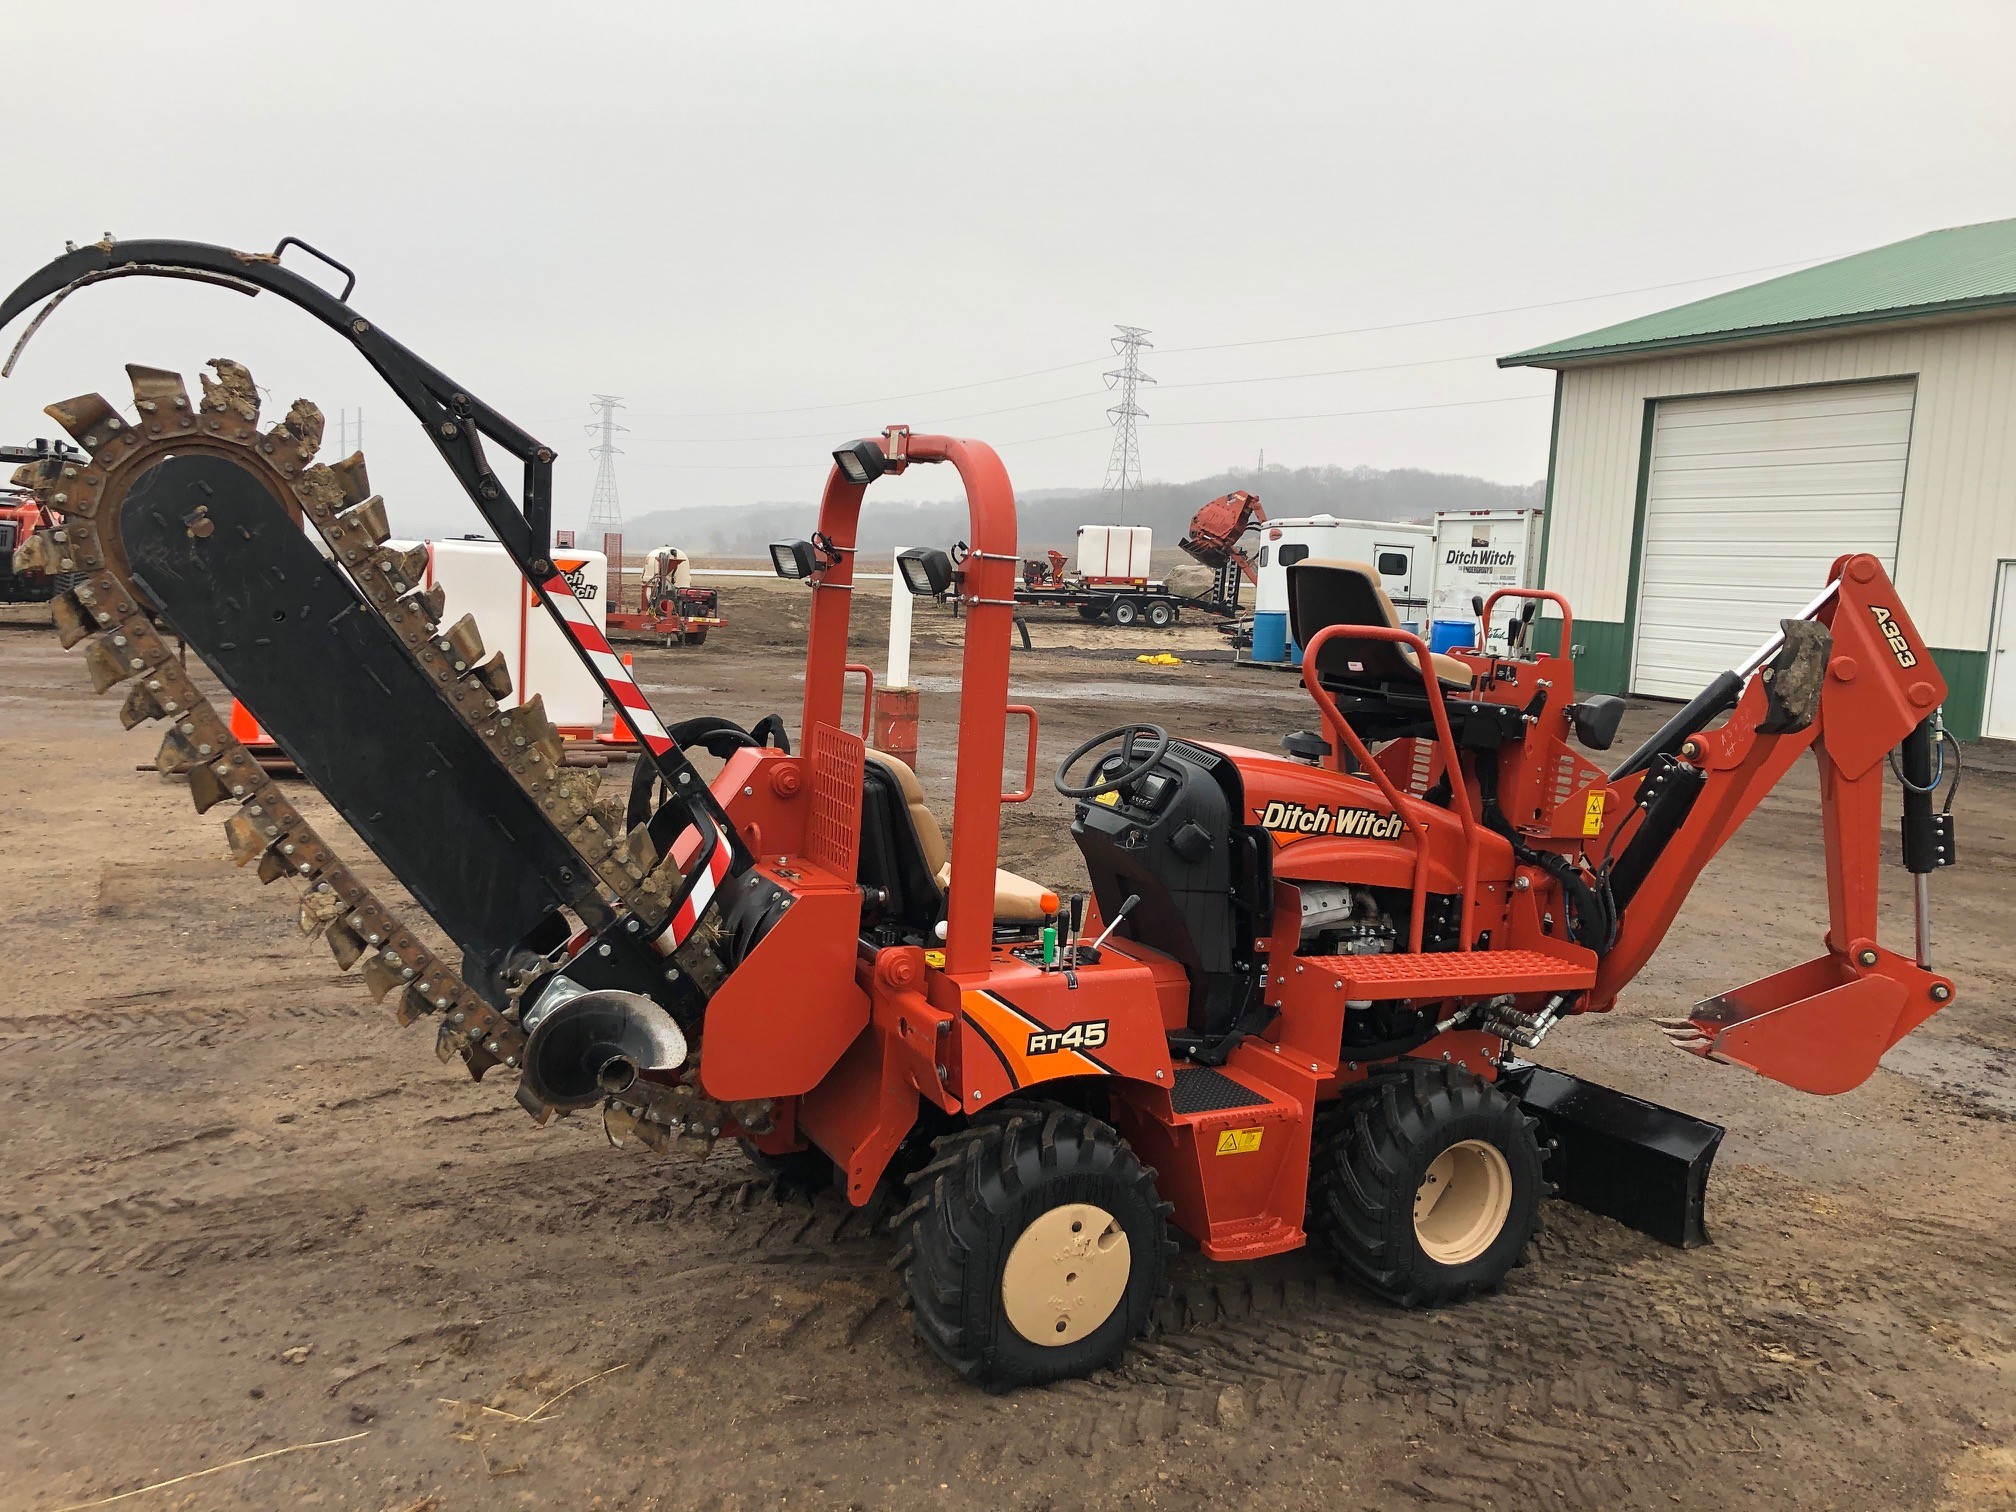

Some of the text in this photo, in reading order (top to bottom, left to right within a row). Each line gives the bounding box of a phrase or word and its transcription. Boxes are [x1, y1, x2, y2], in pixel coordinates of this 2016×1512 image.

[1446, 550, 1515, 565] Ditch Witch
[1869, 606, 1917, 668] A323
[1262, 801, 1403, 839] Ditch Witch
[1029, 1022, 1106, 1052] RT45
